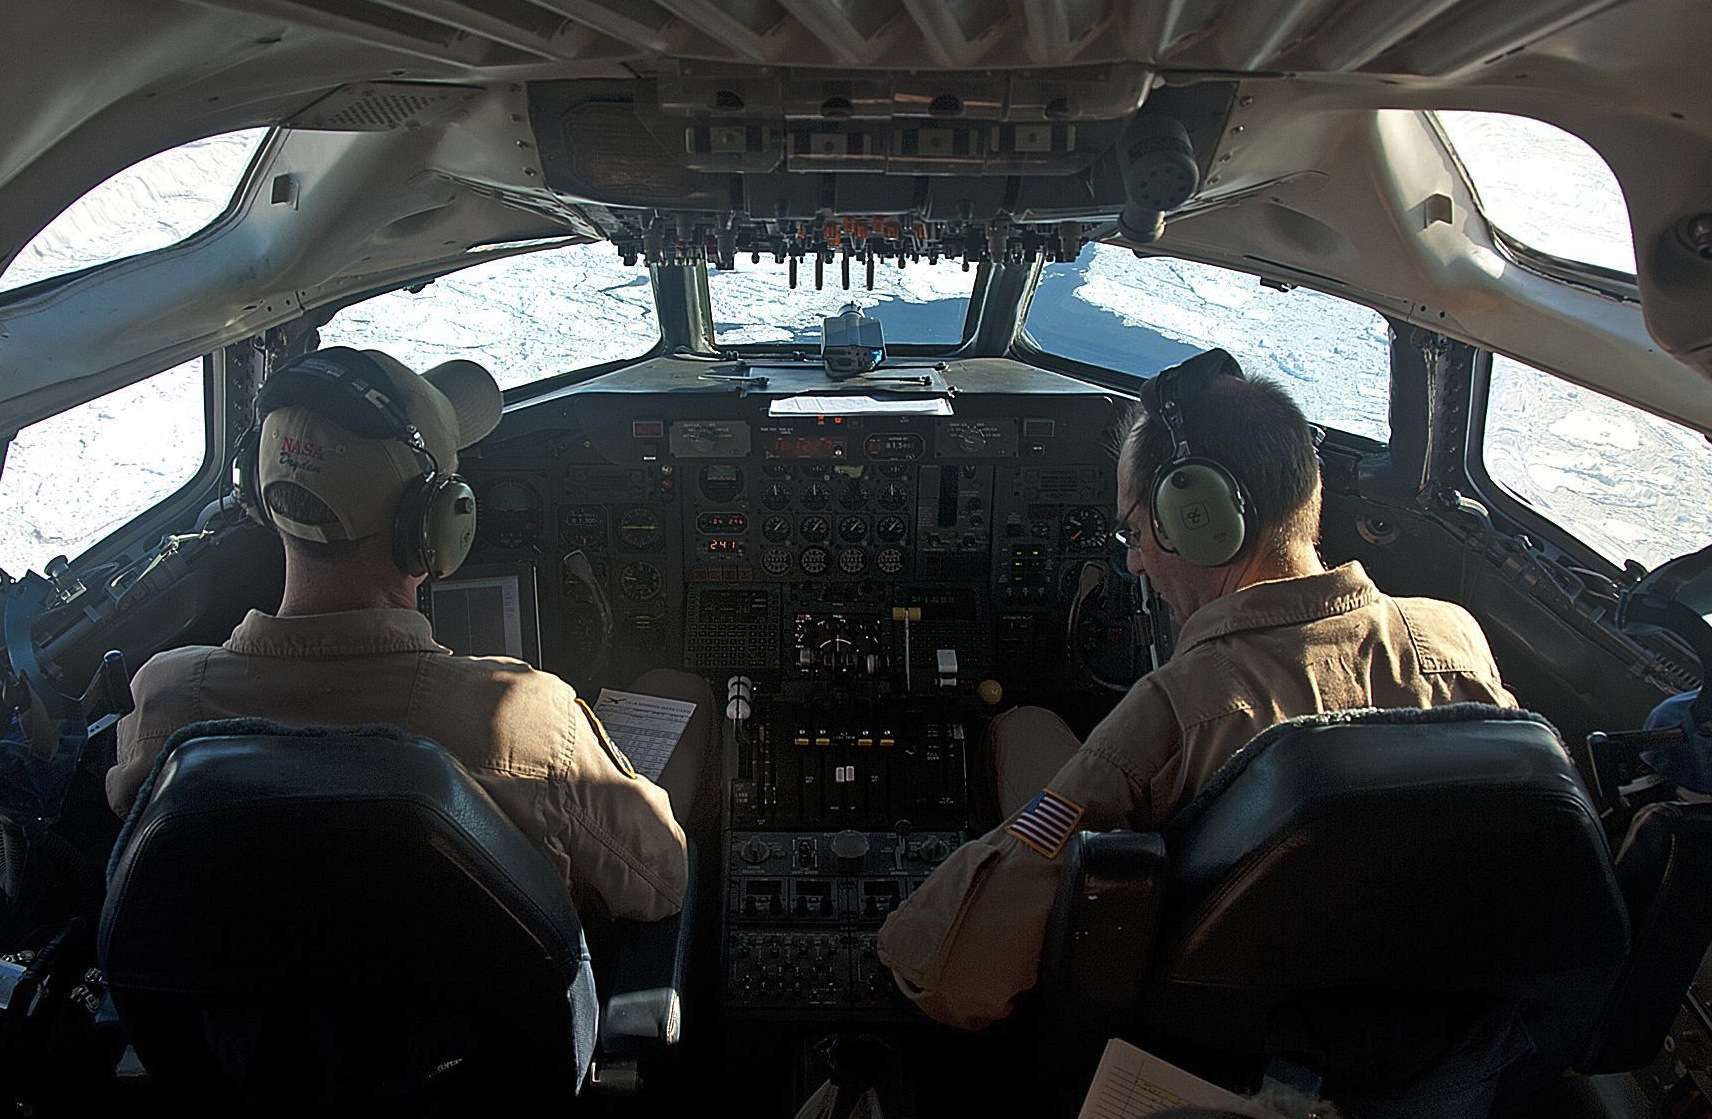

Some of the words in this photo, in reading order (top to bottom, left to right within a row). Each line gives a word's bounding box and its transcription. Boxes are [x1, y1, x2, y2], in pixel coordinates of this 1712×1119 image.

[282, 436, 323, 457] NASA
[279, 451, 322, 472] Dryden
[710, 539, 735, 550] 241
